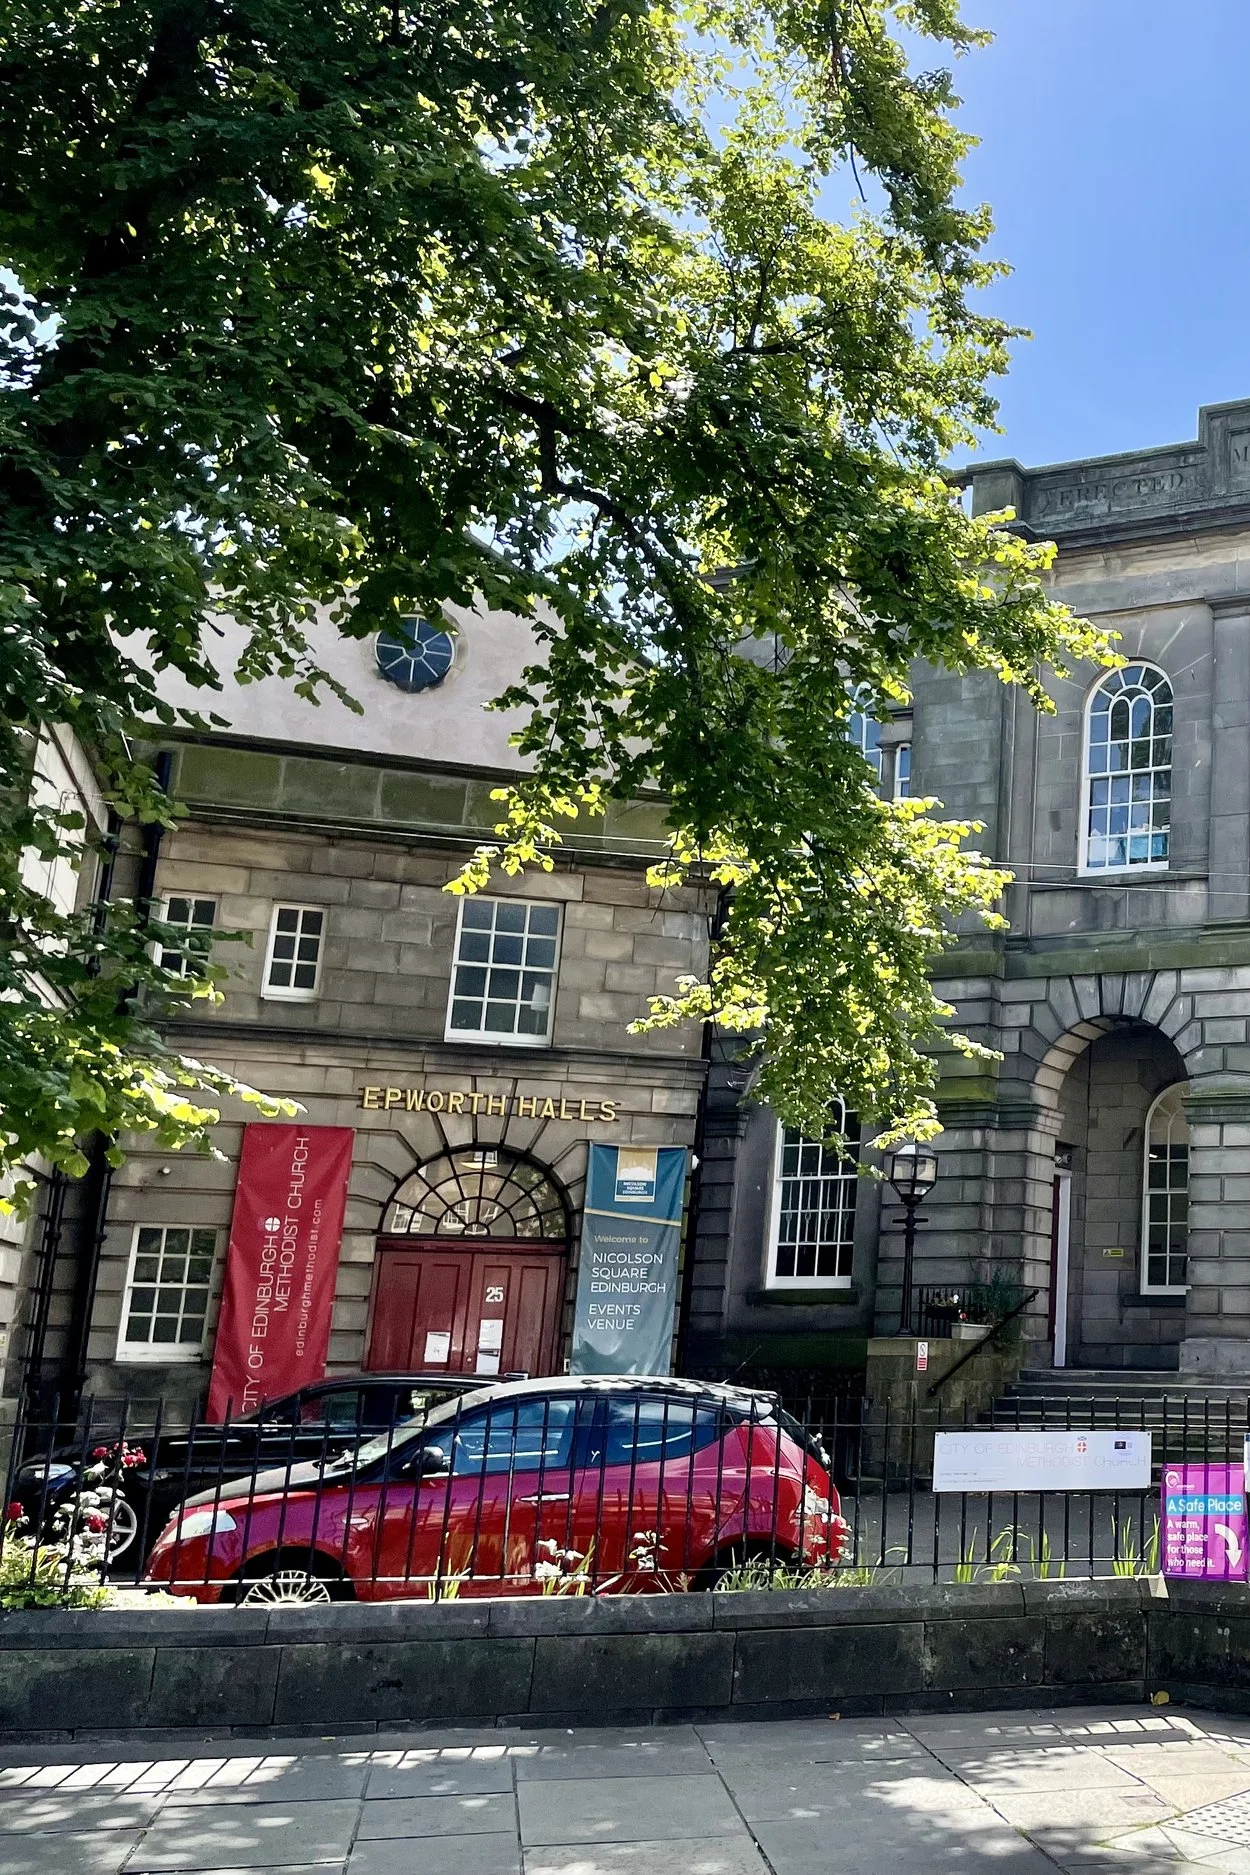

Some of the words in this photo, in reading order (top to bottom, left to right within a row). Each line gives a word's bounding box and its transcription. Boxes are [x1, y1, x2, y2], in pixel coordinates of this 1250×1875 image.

[1058, 472, 1184, 506] ERECTED
[362, 1086, 507, 1117] EPWORTH
[517, 1096, 617, 1122] HALLS
[273, 1215, 298, 1312] METHODIST
[287, 1137, 309, 1209] CHURCH
[594, 1235, 637, 1243] Welcome
[639, 1235, 649, 1244] to
[593, 1252, 663, 1264] NICOLSON
[296, 1199, 322, 1357] edinburghmethodist.com
[591, 1267, 648, 1280] SQUARE
[251, 1235, 279, 1338] EDINBURGH
[590, 1282, 666, 1293] EDINBURGH
[485, 1286, 504, 1302] 25
[589, 1304, 641, 1315] EVENTS
[587, 1318, 634, 1330] VENUE
[248, 1344, 264, 1369] OF
[940, 1443, 968, 1455] CITY
[974, 1443, 992, 1454] OF
[997, 1443, 1073, 1454] EDINBURGH
[1016, 1456, 1088, 1468] METHODIST
[1168, 1499, 1177, 1512] A
[1179, 1498, 1205, 1512] Safe
[1208, 1498, 1242, 1512] Place
[1167, 1520, 1174, 1529] A
[1175, 1520, 1200, 1530] warm,
[1167, 1532, 1186, 1542] safe
[1186, 1532, 1208, 1544] place
[1167, 1545, 1180, 1555] for
[1181, 1545, 1204, 1555] those
[1168, 1556, 1184, 1568] who
[1186, 1557, 1206, 1568] need
[1207, 1558, 1216, 1568] it.
